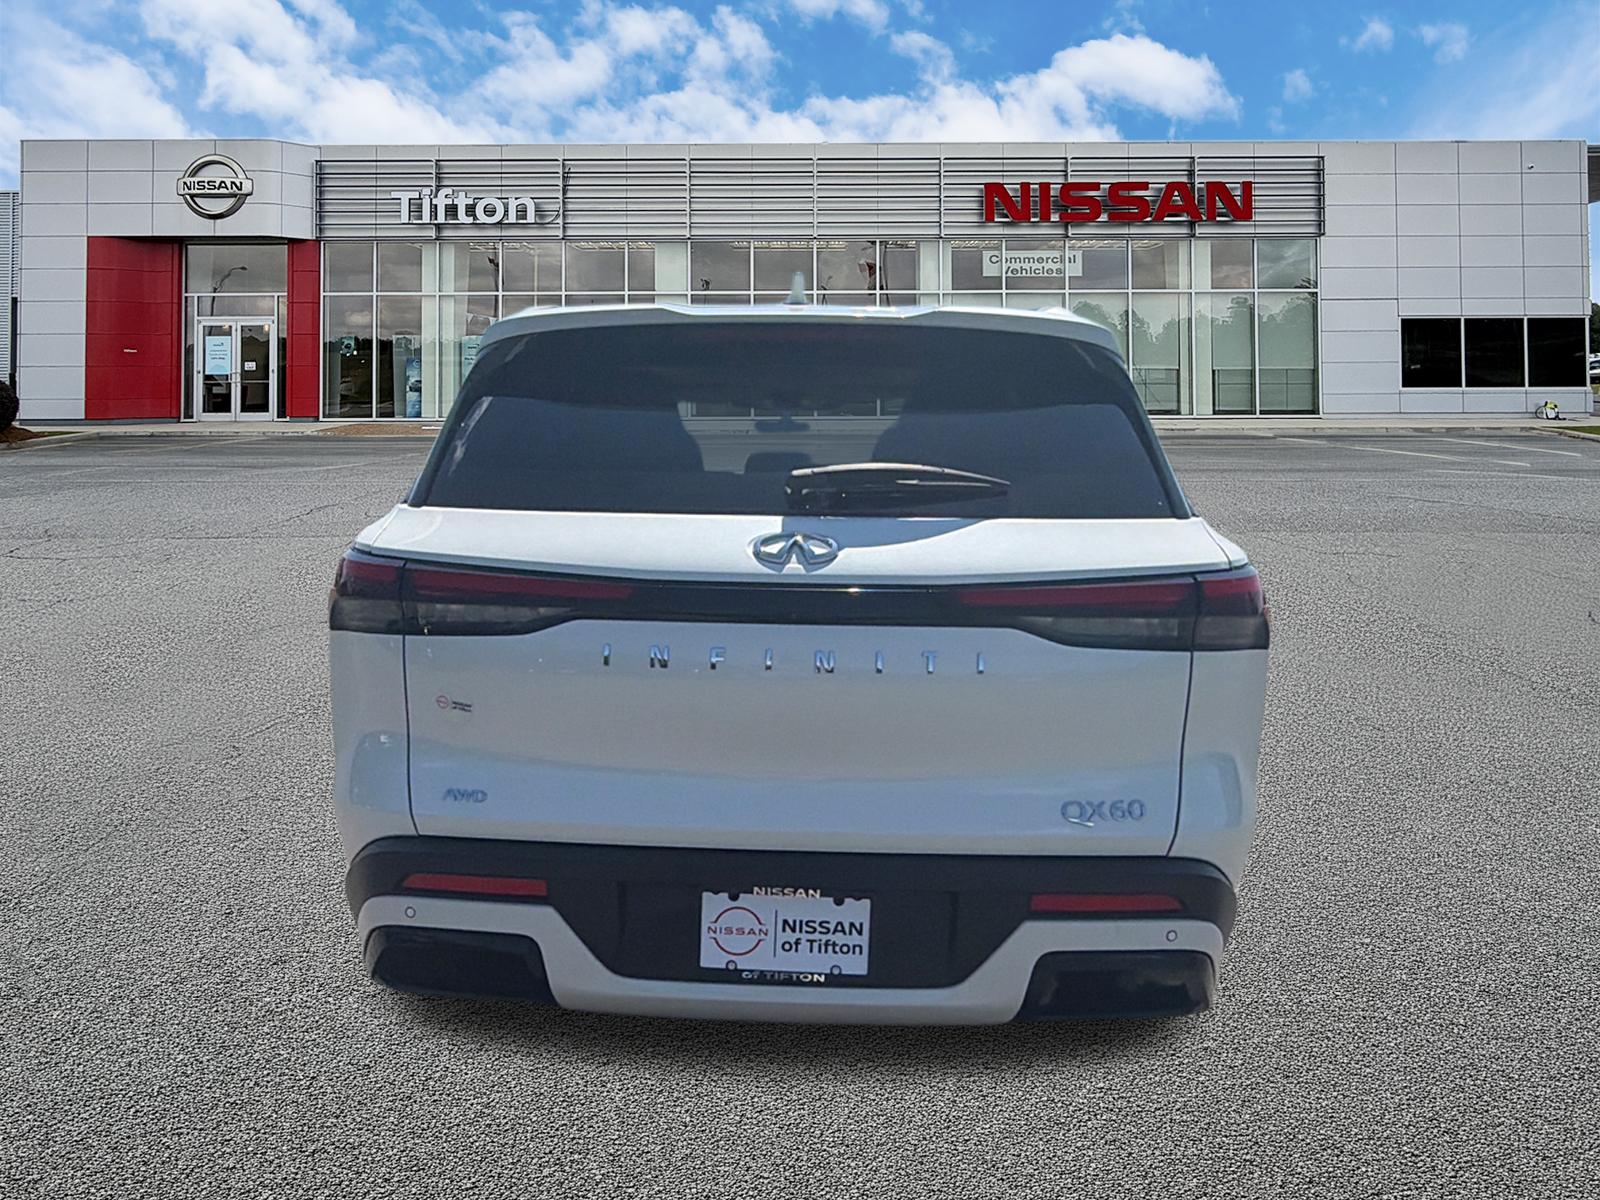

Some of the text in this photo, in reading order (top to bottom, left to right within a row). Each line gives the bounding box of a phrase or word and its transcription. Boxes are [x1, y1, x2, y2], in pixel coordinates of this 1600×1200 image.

[183, 181, 243, 191] NISSAN
[391, 187, 536, 224] Tifton
[984, 181, 1253, 223] NISSAN
[602, 643, 986, 674] INFINITI
[442, 788, 488, 803] AWD
[1061, 799, 1146, 828] QX60
[753, 886, 821, 899] NISSAN
[707, 926, 768, 937] NISSAN
[782, 919, 864, 936] NISSAN
[781, 938, 864, 955] of Tifton
[763, 972, 826, 983] TIFTON
